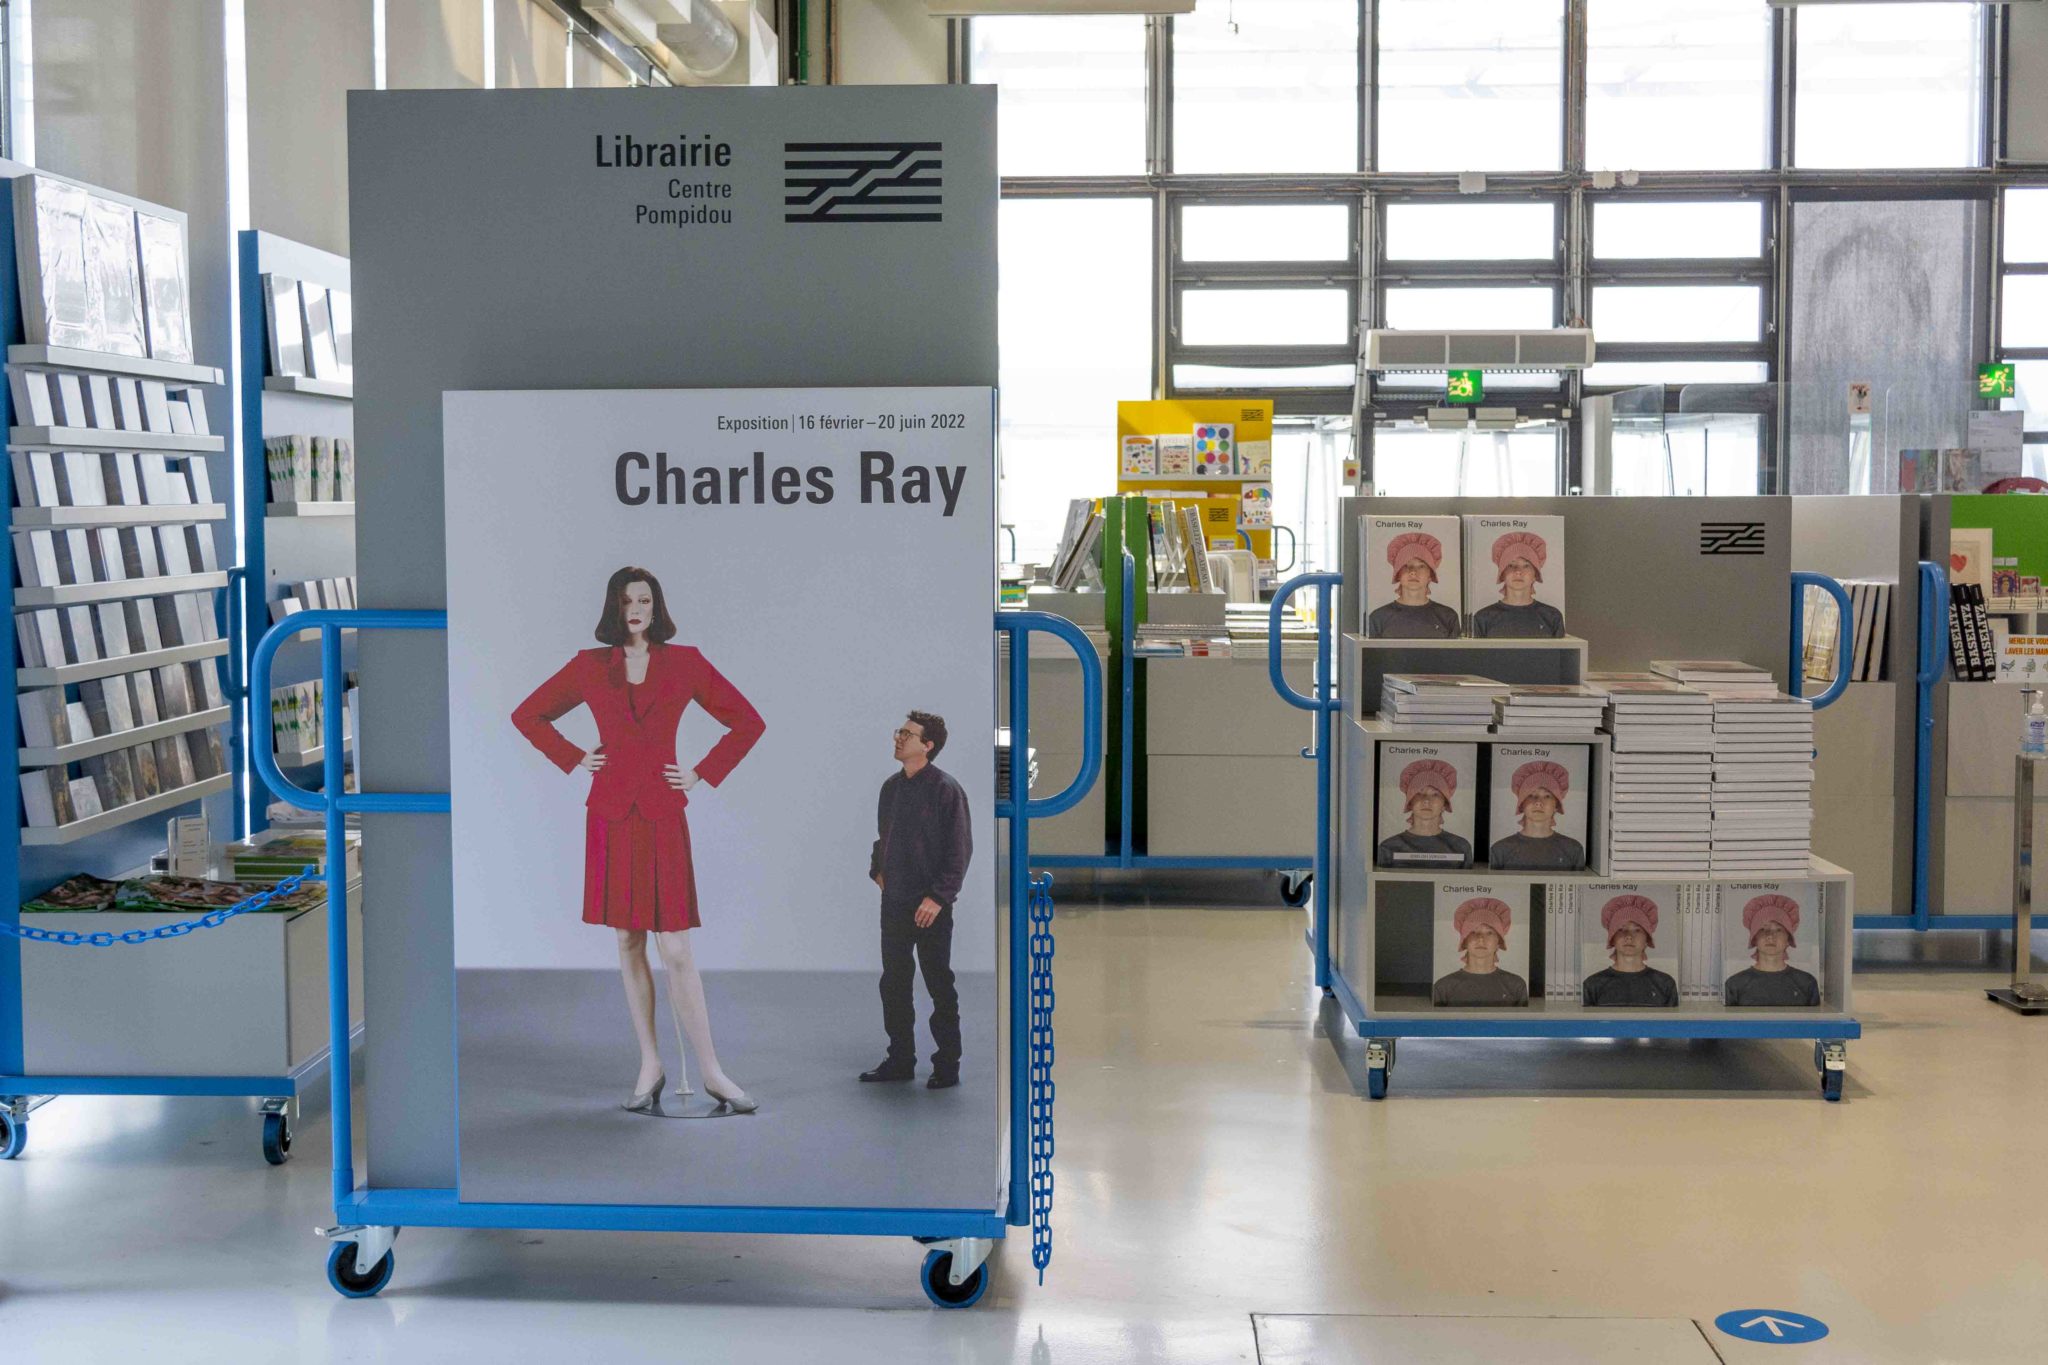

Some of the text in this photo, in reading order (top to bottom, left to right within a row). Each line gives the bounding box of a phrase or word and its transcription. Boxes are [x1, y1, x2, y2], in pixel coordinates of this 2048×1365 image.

[597, 134, 732, 168] Librairie
[668, 178, 732, 199] Centre
[636, 204, 732, 229] Pompidou
[717, 415, 789, 433] Exposition
[799, 414, 815, 430] 16
[899, 414, 926, 432] juin
[930, 413, 965, 429] 2022
[615, 450, 968, 517] Charles Ray
[1375, 520, 1423, 529] Charles Ray
[1480, 519, 1528, 528] Charles Ray
[1961, 603, 1980, 667] BASELITZ
[1974, 603, 1995, 667] BASELITZ
[1388, 746, 1439, 756] Charles Ray
[1500, 747, 1551, 758] Charles Ray
[1442, 885, 1492, 894] Charles Ray
